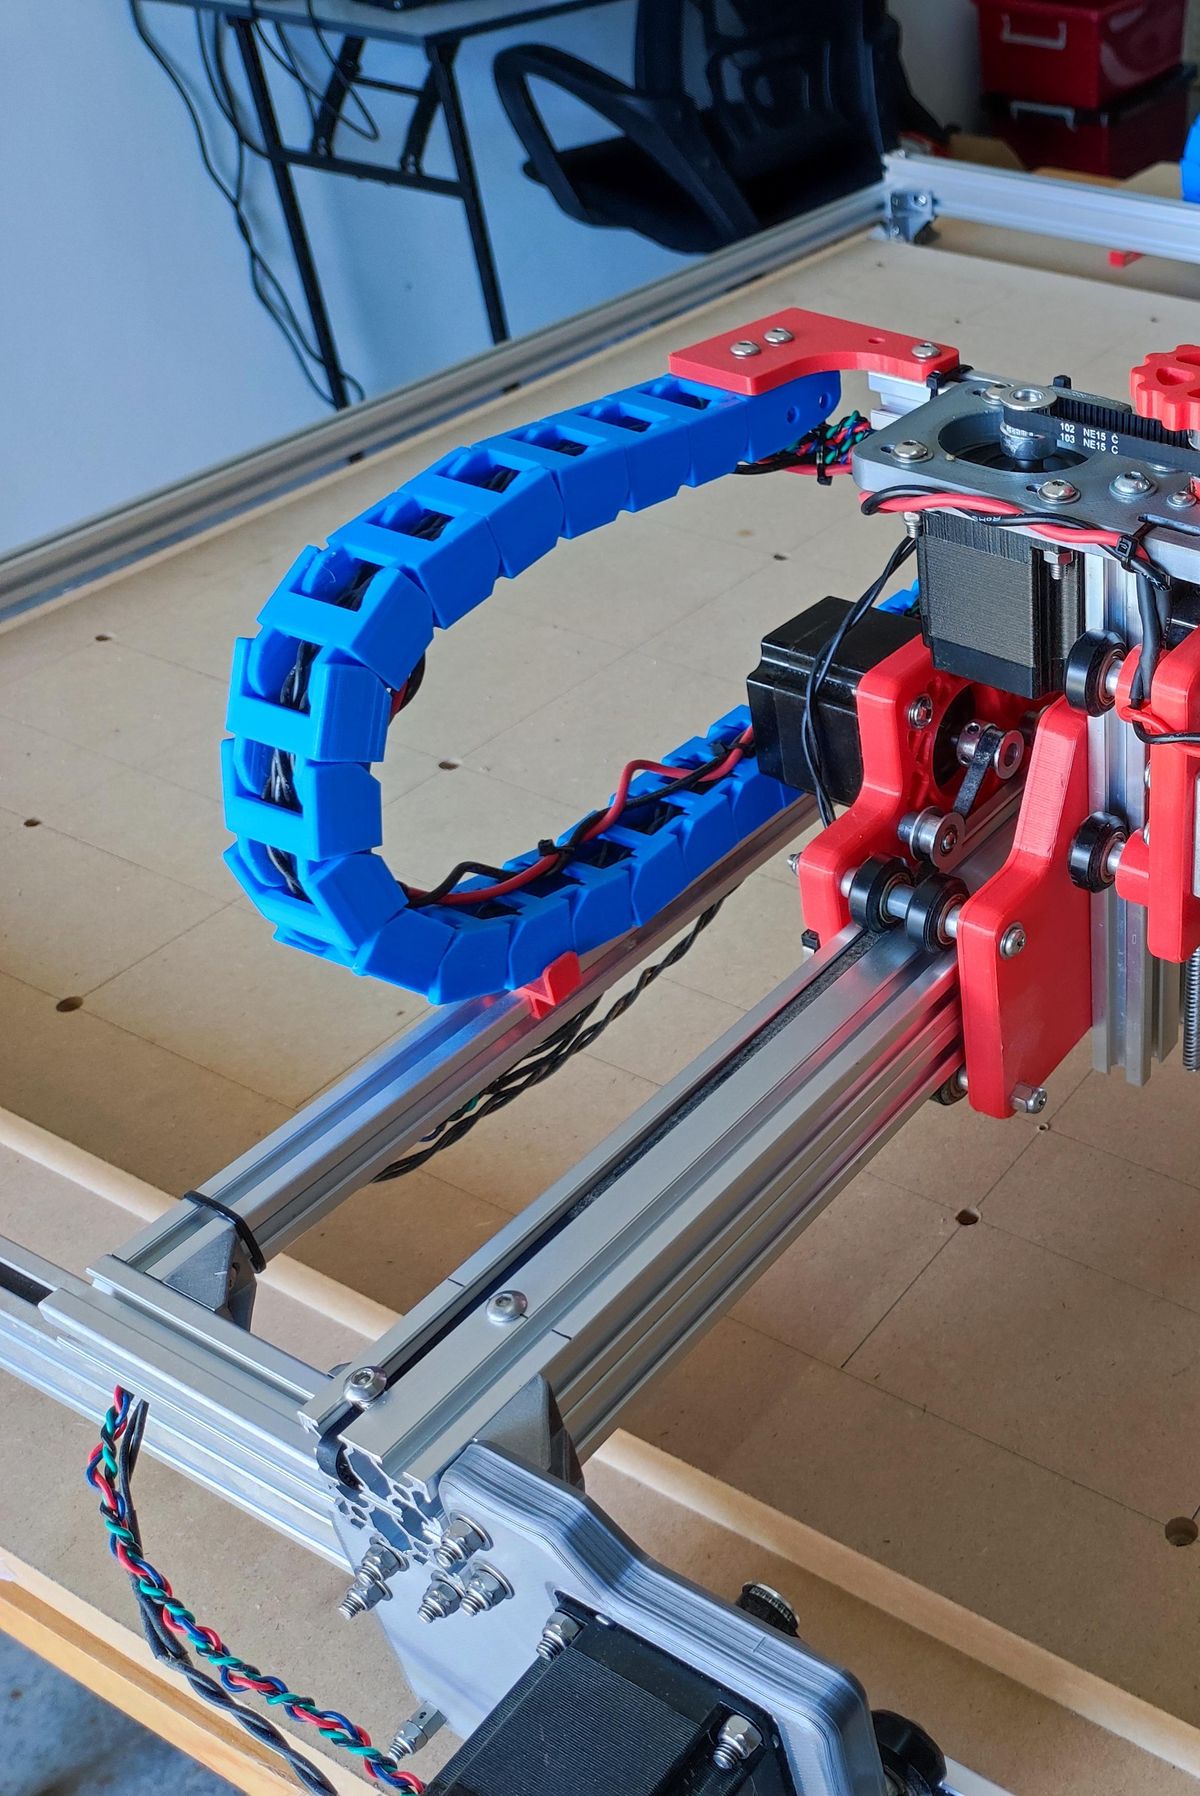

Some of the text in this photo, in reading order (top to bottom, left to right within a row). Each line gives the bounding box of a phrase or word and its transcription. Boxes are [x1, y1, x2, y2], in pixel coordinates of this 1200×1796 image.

[1060, 422, 1119, 444] 102 NE15 C
[1060, 432, 1119, 455] 103 NE15 C
